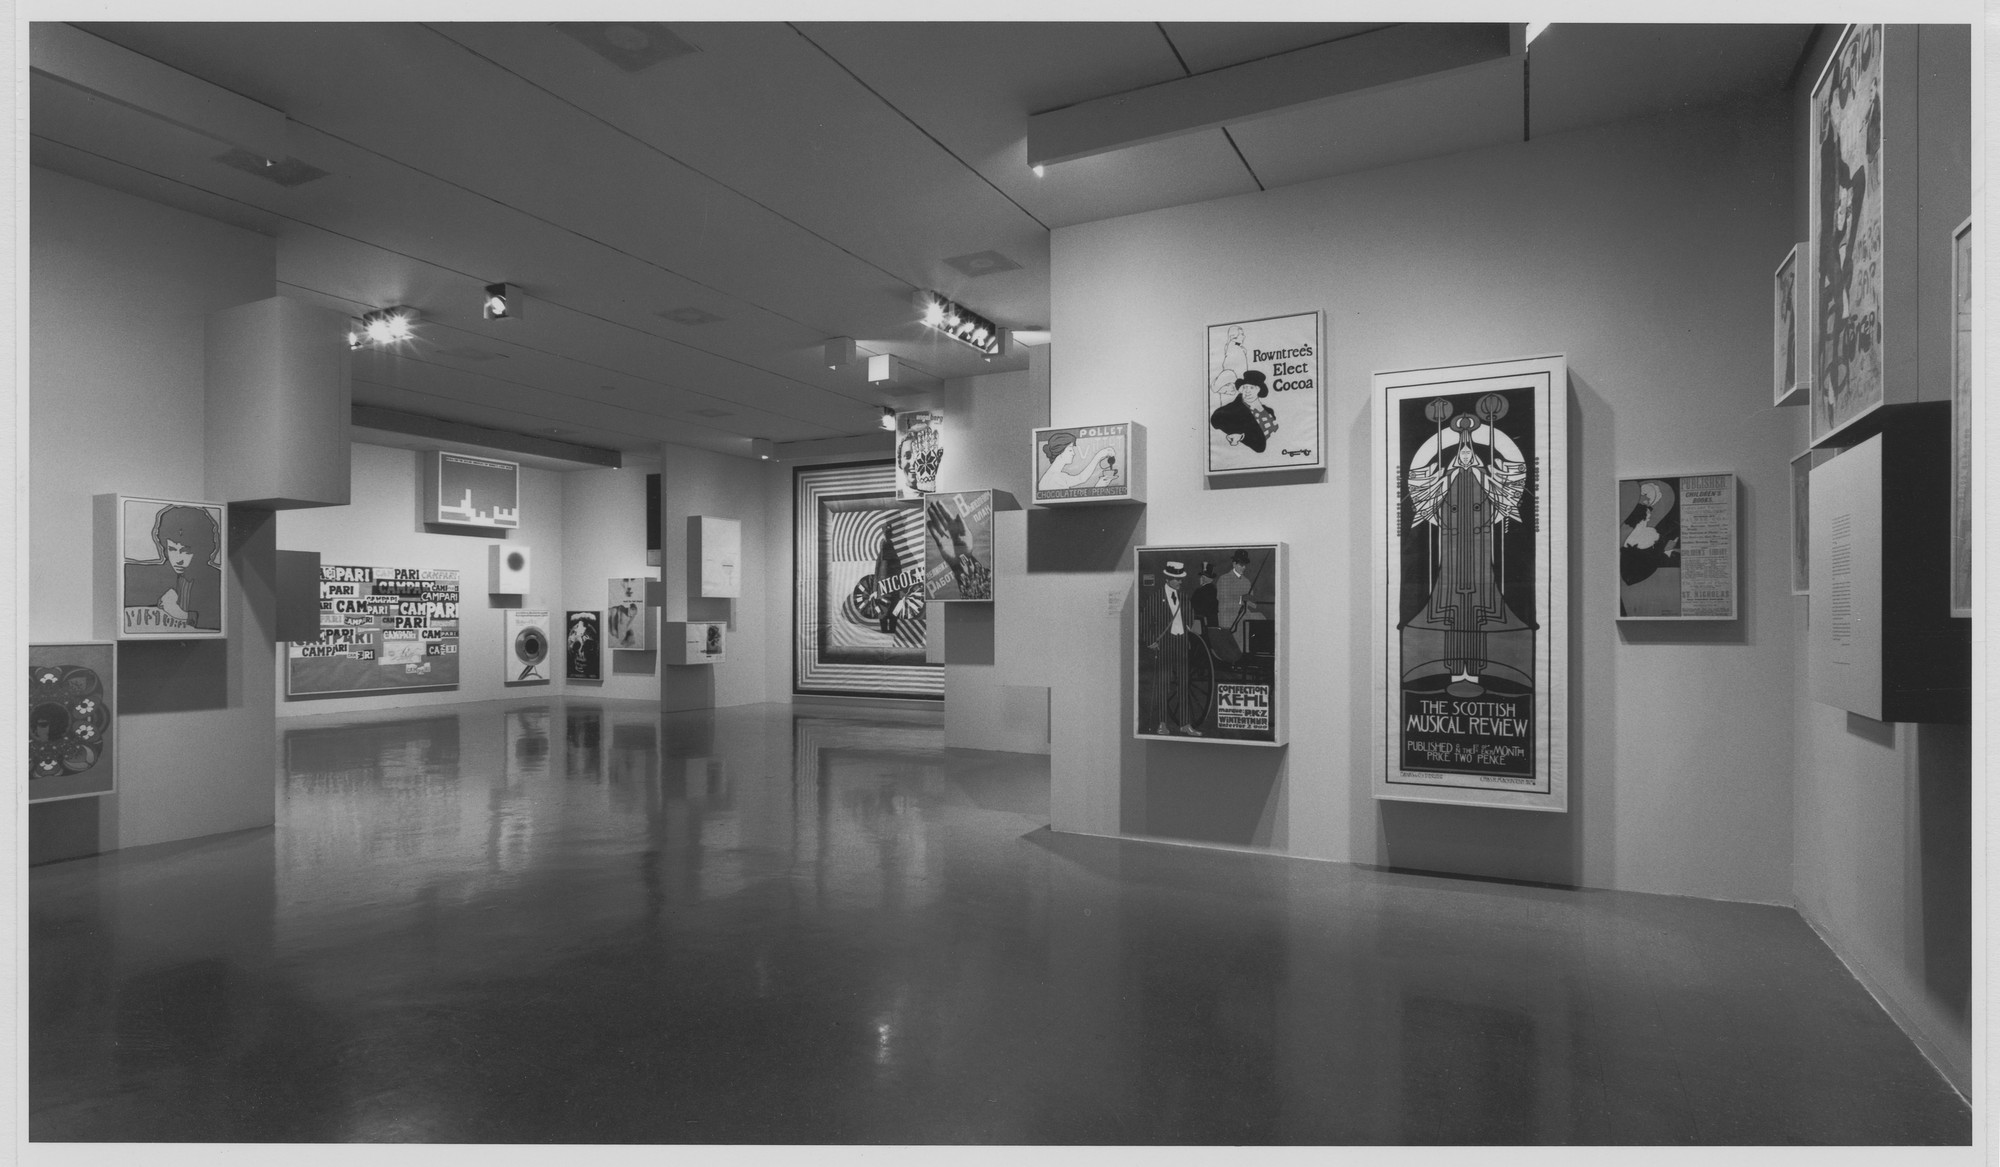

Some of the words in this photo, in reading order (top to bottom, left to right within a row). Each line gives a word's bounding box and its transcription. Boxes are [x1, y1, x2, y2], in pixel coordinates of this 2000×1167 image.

[1253, 343, 1313, 362] Rowntree's
[1273, 362, 1308, 376] Elect
[1272, 378, 1314, 391] Cocoa
[1079, 426, 1123, 437] POLLET
[421, 592, 458, 601] CAMPARI
[1218, 685, 1268, 695] CONFECTION
[1218, 694, 1268, 707] KEHL
[1420, 700, 1448, 715] THE
[1452, 702, 1516, 717] SCOTTISH
[1406, 714, 1465, 734] MUSICAL
[1469, 717, 1528, 737] REVIEW
[1407, 740, 1453, 753] PUBLISHED
[1494, 745, 1524, 757] MONTH
[1427, 751, 1450, 762] PRICE
[1454, 752, 1472, 763] TWO
[1477, 754, 1506, 766] PENCE
